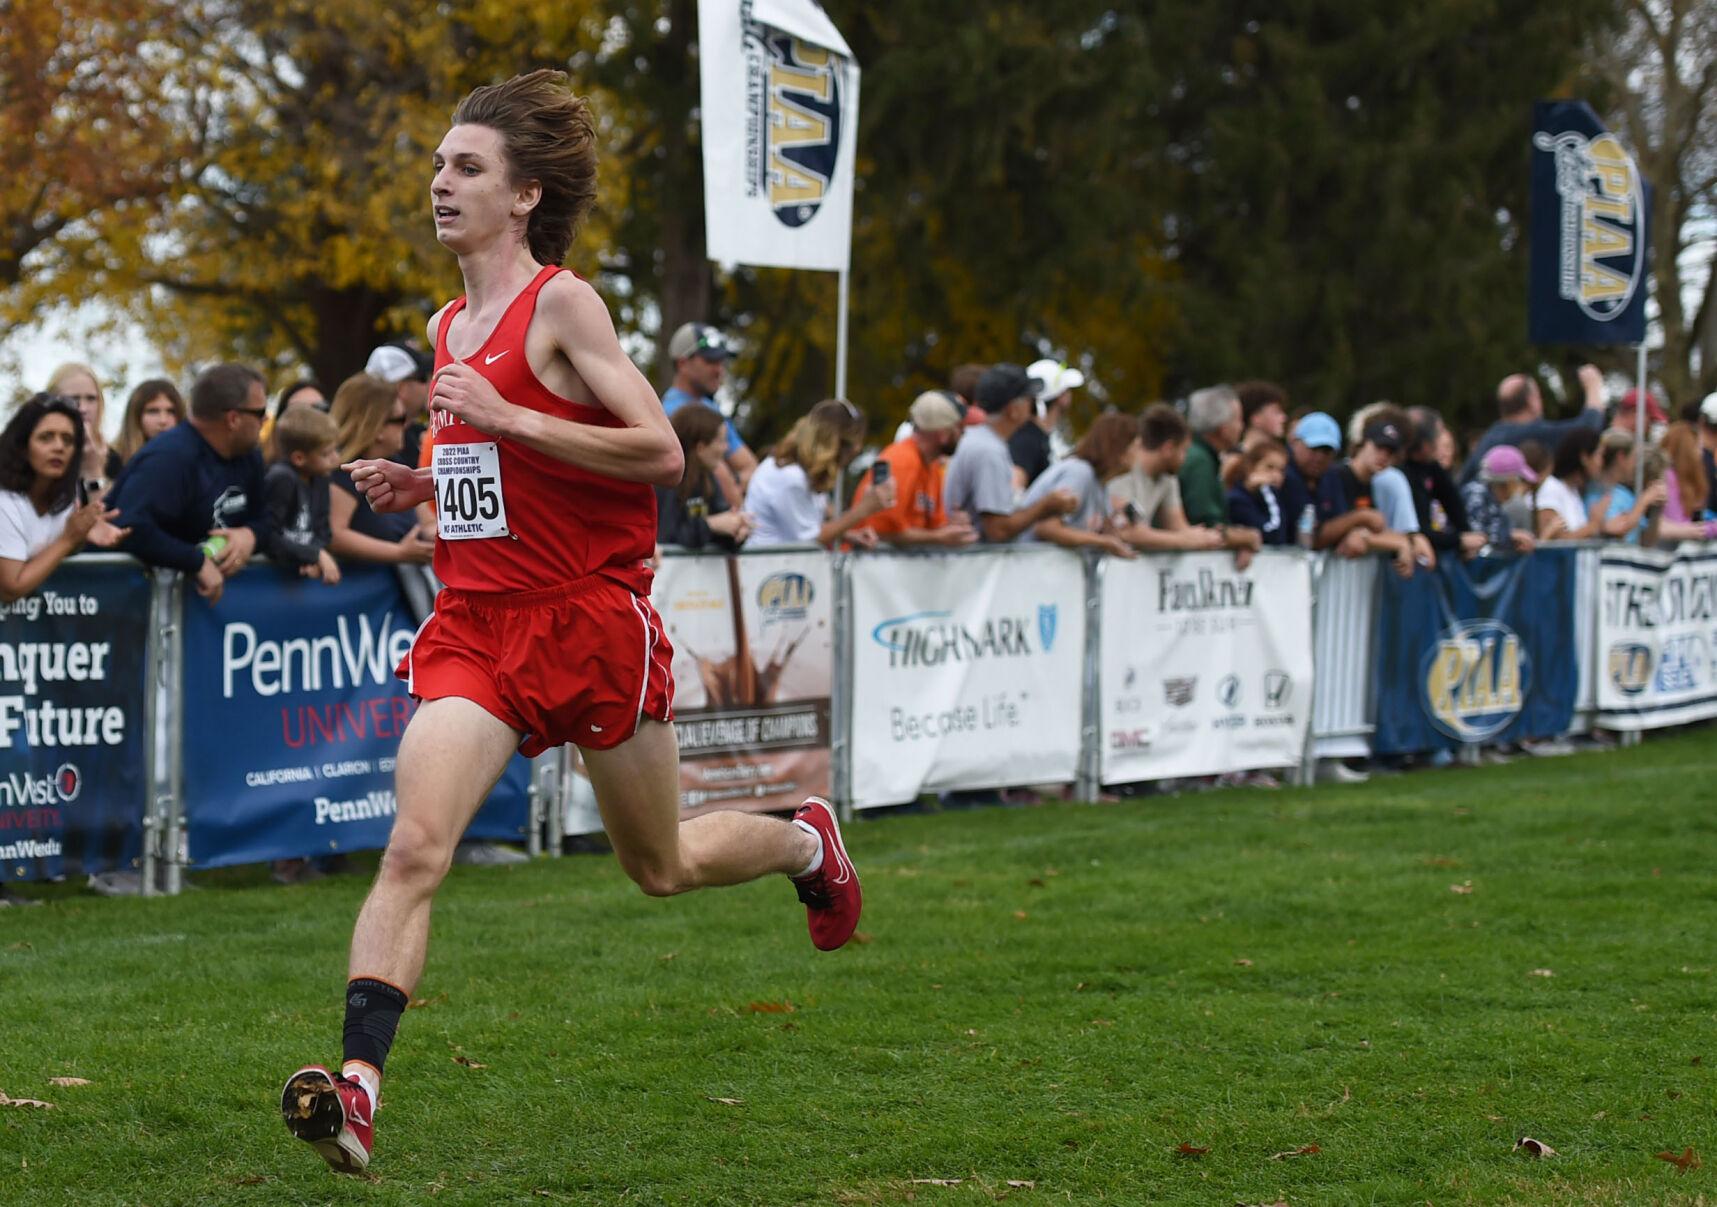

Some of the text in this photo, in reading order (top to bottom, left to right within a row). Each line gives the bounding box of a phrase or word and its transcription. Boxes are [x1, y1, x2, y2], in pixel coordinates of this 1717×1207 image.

[1578, 158, 1634, 306] PIAA
[442, 446, 470, 457] 2022 PIAA
[437, 456, 480, 466] CROSS COUNTRY
[437, 465, 482, 476] CHAMPIONSHIPS
[434, 476, 499, 521] 1405
[450, 523, 484, 533] ATHLETIC
[43, 591, 77, 615] You
[79, 594, 99, 615] to
[245, 766, 313, 787] CALIFORNIA
